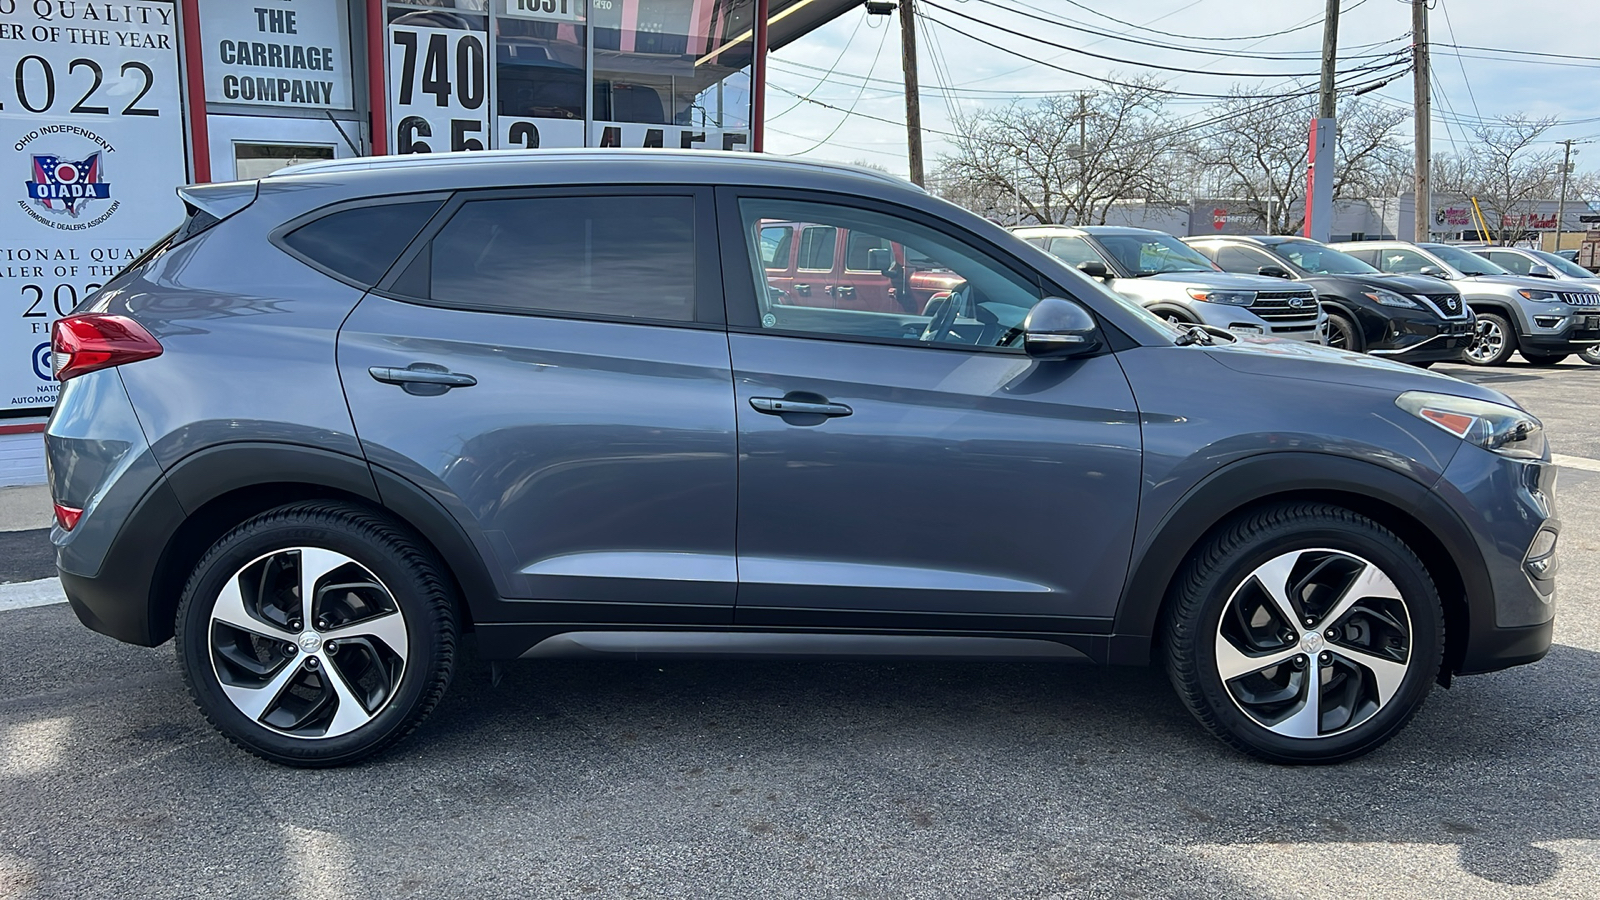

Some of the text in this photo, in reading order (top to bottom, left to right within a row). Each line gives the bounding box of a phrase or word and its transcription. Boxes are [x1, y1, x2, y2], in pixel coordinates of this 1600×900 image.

[33, 0, 172, 26] QUALITY
[254, 8, 297, 34] THE
[32, 26, 60, 43] OF
[66, 28, 110, 46] THE
[116, 32, 171, 49] YEAR
[220, 40, 334, 71] CARRIAGE
[394, 31, 485, 109] 740
[0, 54, 160, 117] 022
[223, 75, 334, 104] COMPANY
[14, 125, 115, 153] OHIO INDEPENDENT
[37, 184, 97, 198] OIADA
[17, 200, 120, 231] AUTOMOBILE DEALERS ASSOCIATION
[54, 266, 79, 278] OF
